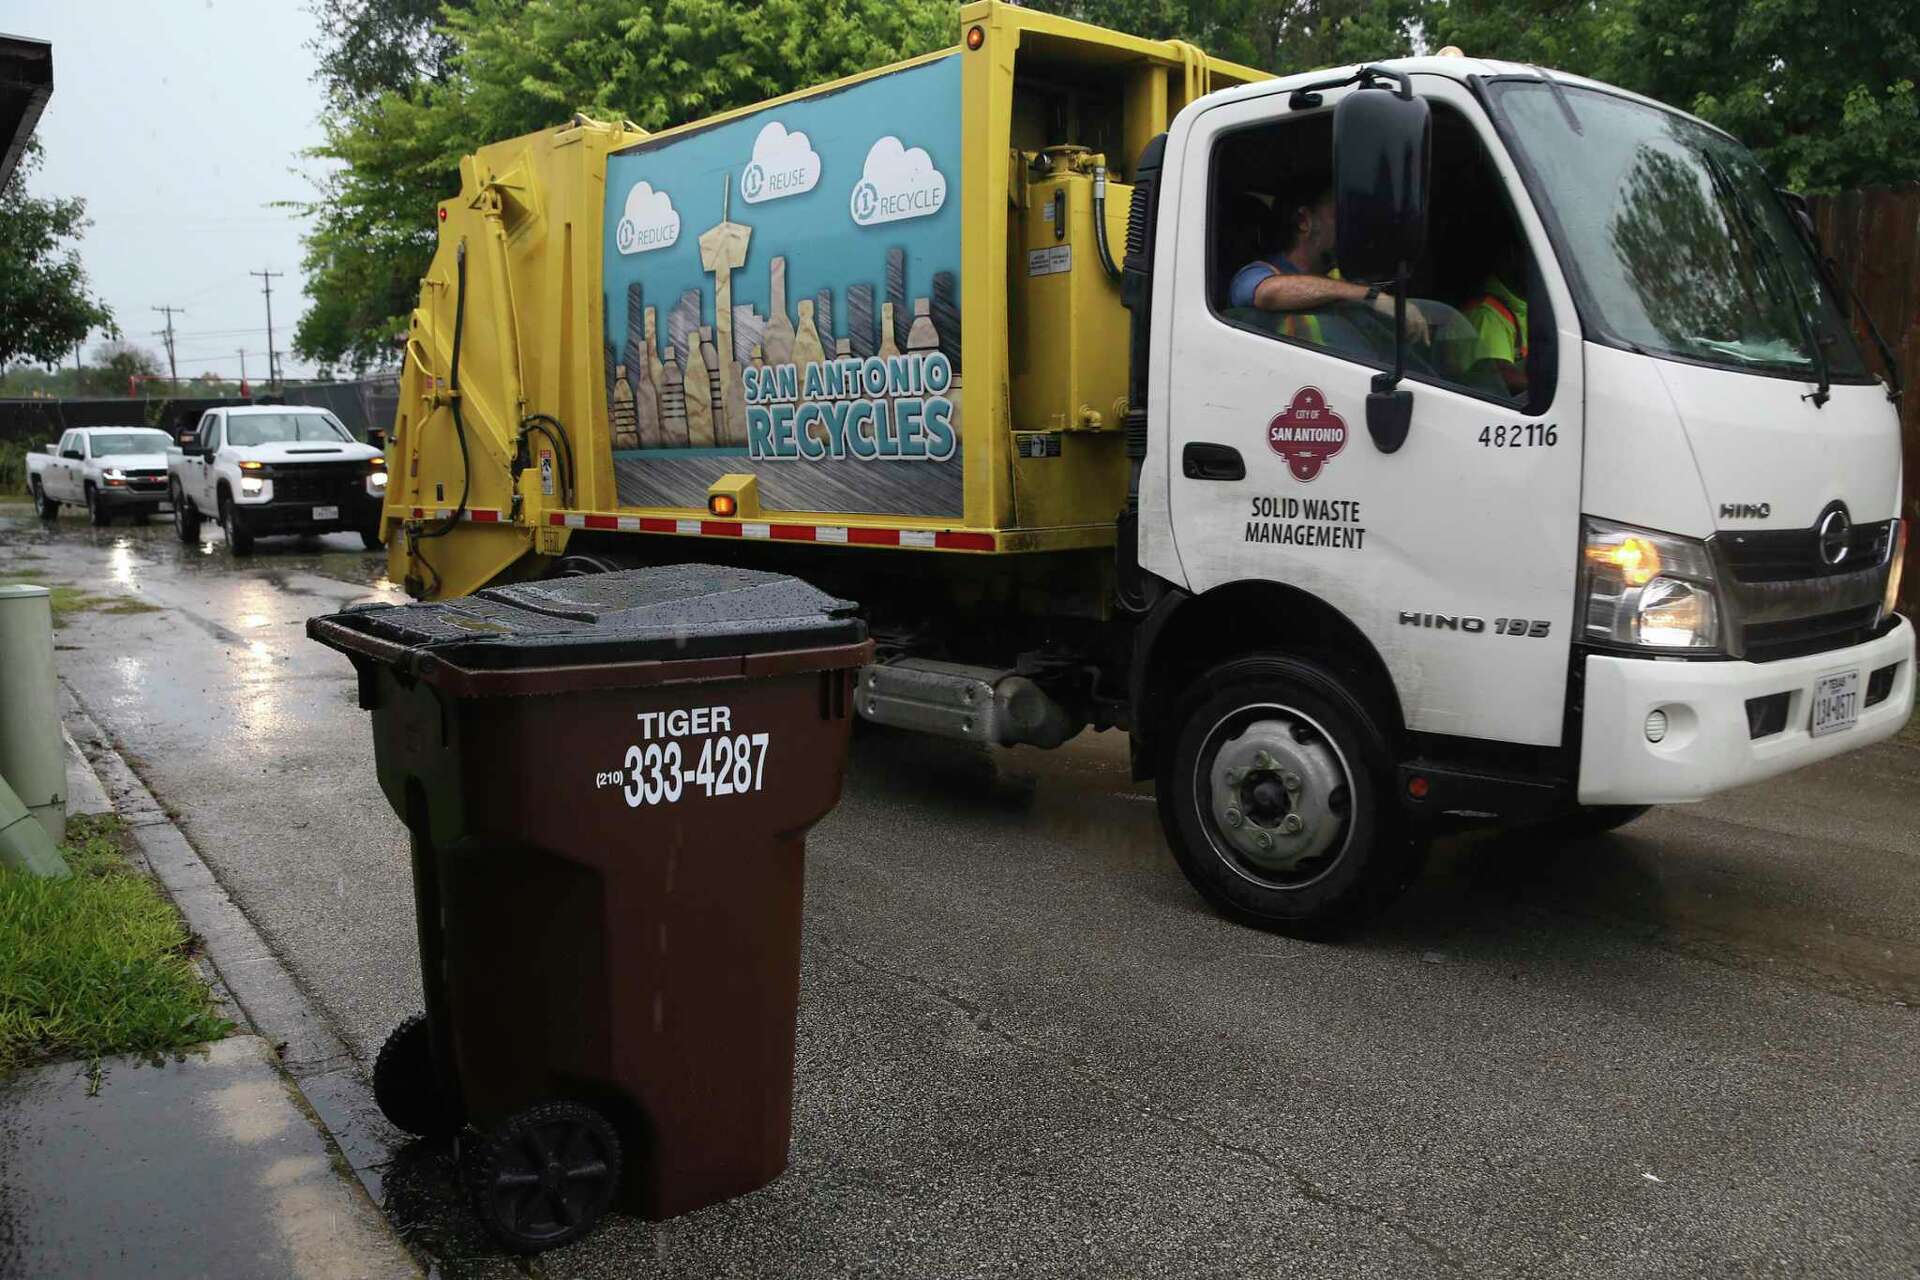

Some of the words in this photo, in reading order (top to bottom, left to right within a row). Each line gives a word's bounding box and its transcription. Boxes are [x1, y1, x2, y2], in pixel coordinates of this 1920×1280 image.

[769, 167, 806, 192] REUSE
[880, 186, 942, 215] RECYCLE
[638, 224, 675, 246] REDUCE
[744, 363, 798, 402] SAN
[804, 352, 952, 399] ANTONIO
[1296, 409, 1310, 419] CITY
[1311, 409, 1320, 419] OF
[745, 398, 955, 462] RECYCLES
[1271, 427, 1293, 441] SAN
[1293, 428, 1344, 442] ANTONIO
[1478, 424, 1558, 448] 482116
[1251, 497, 1299, 519] SOLID
[1303, 499, 1361, 523] WASTE
[1720, 502, 1770, 519] HINO
[1245, 522, 1366, 550] MANAGEMENT
[1399, 610, 1485, 633] HINO
[1494, 617, 1552, 638] 195
[637, 705, 731, 739] TIGER
[596, 771, 624, 789] (210)
[624, 733, 770, 808] 333-4287
